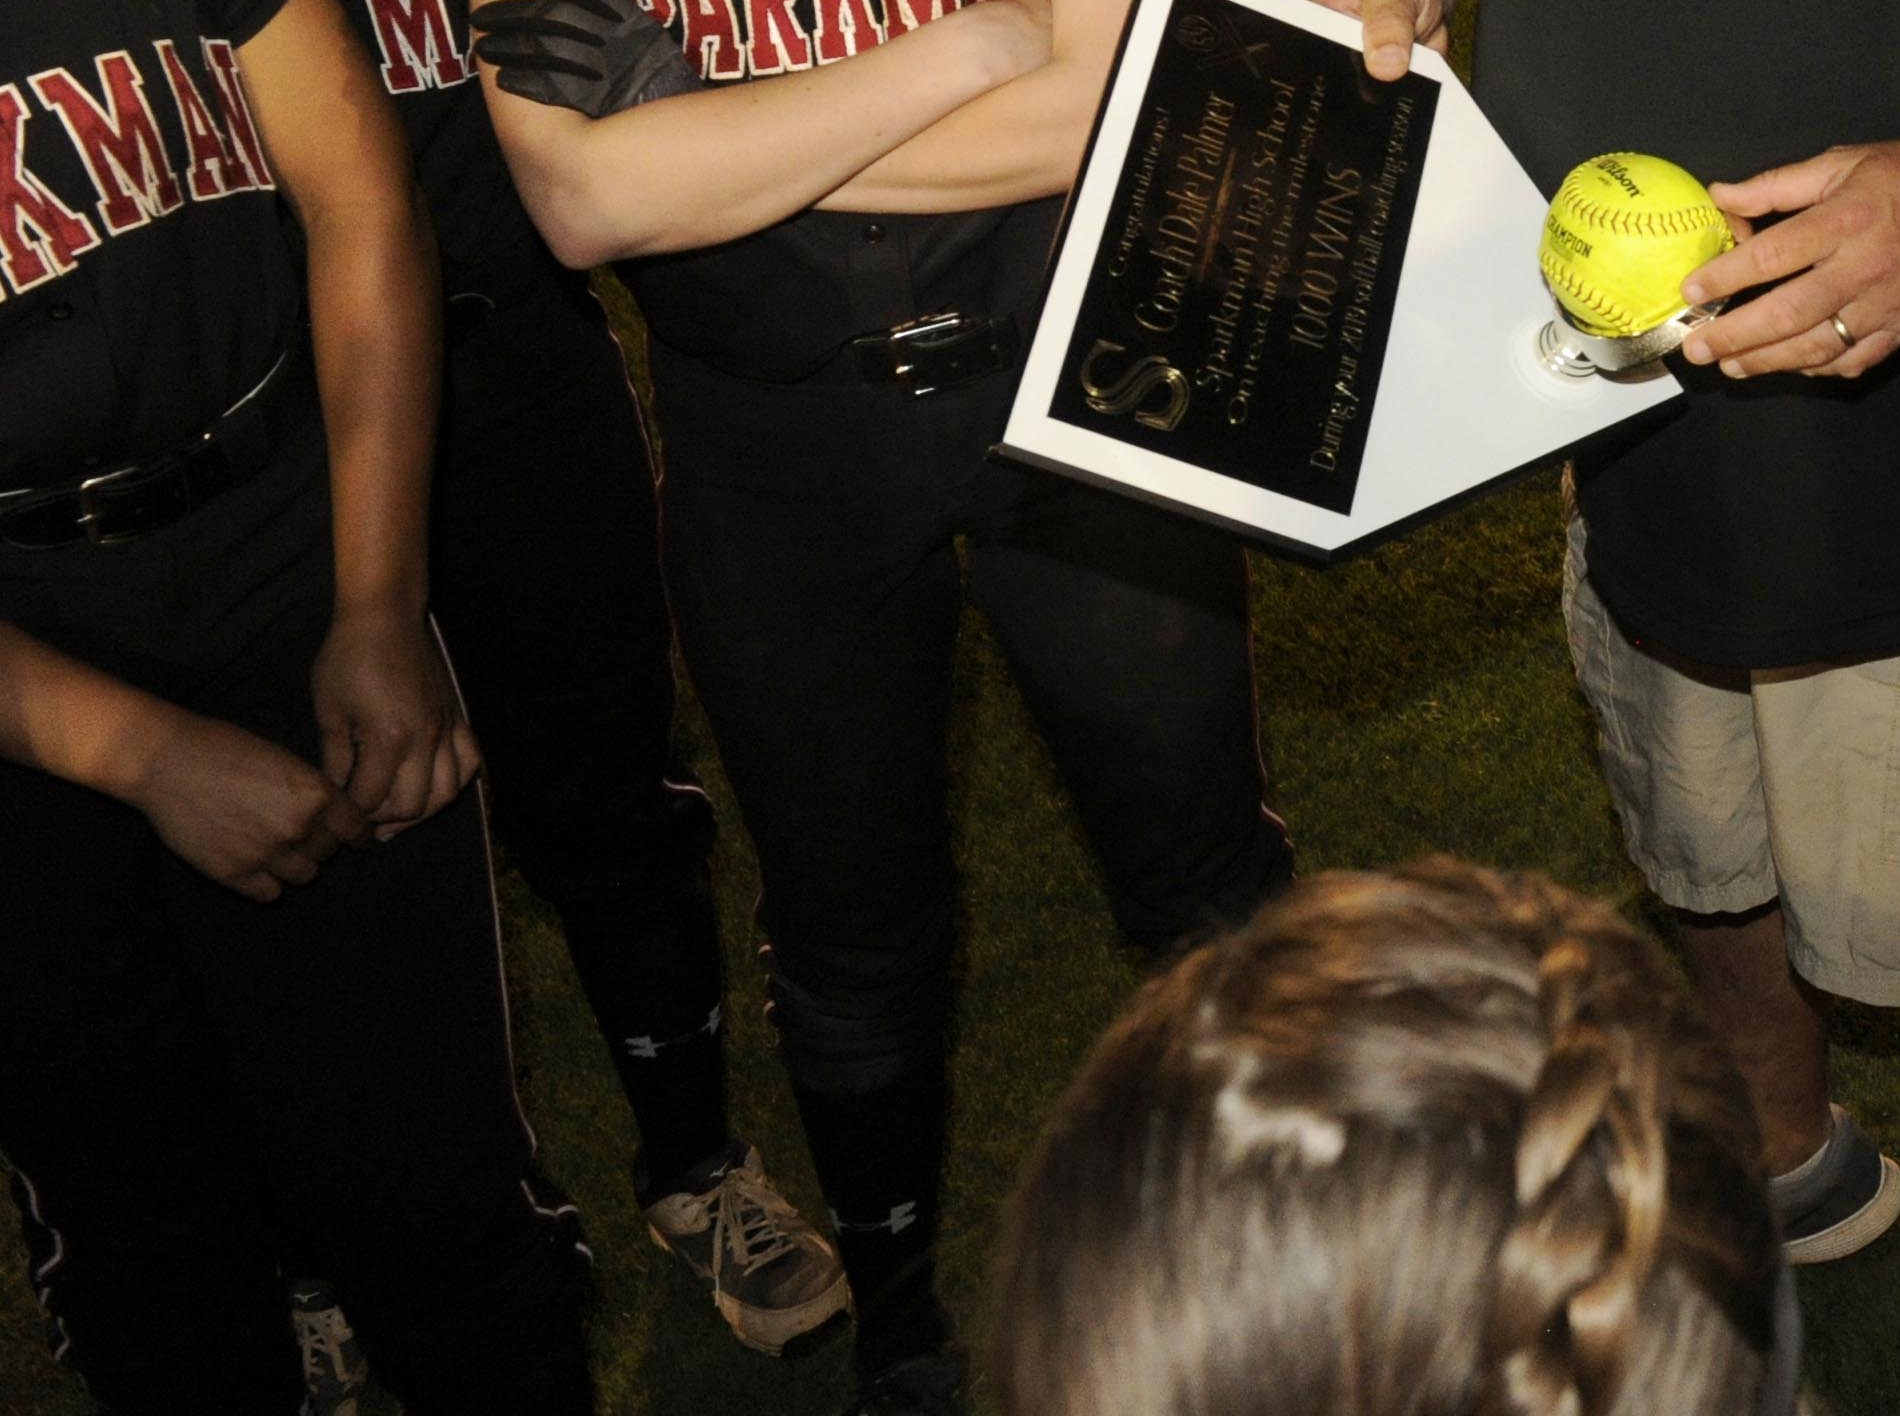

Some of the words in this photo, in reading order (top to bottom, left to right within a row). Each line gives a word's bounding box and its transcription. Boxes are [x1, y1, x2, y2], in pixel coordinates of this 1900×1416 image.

[1176, 91, 1235, 181] Palmer
[1251, 79, 1292, 174] School
[1108, 106, 1170, 278] Congratulations!
[1158, 181, 1211, 244] Dale
[1231, 176, 1275, 242] High
[1305, 162, 1361, 260] WINS
[1597, 159, 1641, 198] Wilson
[1134, 241, 1189, 332] Coach
[1227, 378, 1255, 426] On
[1243, 251, 1291, 372] reaching
[1271, 204, 1293, 248] the
[1286, 75, 1325, 200] milestone
[1196, 241, 1255, 393] Sparkman
[1289, 268, 1338, 349] 1000
[1309, 401, 1357, 472] During
[1334, 354, 1361, 403] your
[1351, 234, 1383, 303] softball
[1369, 156, 1409, 237] coaching
[1080, 338, 1190, 432] S
